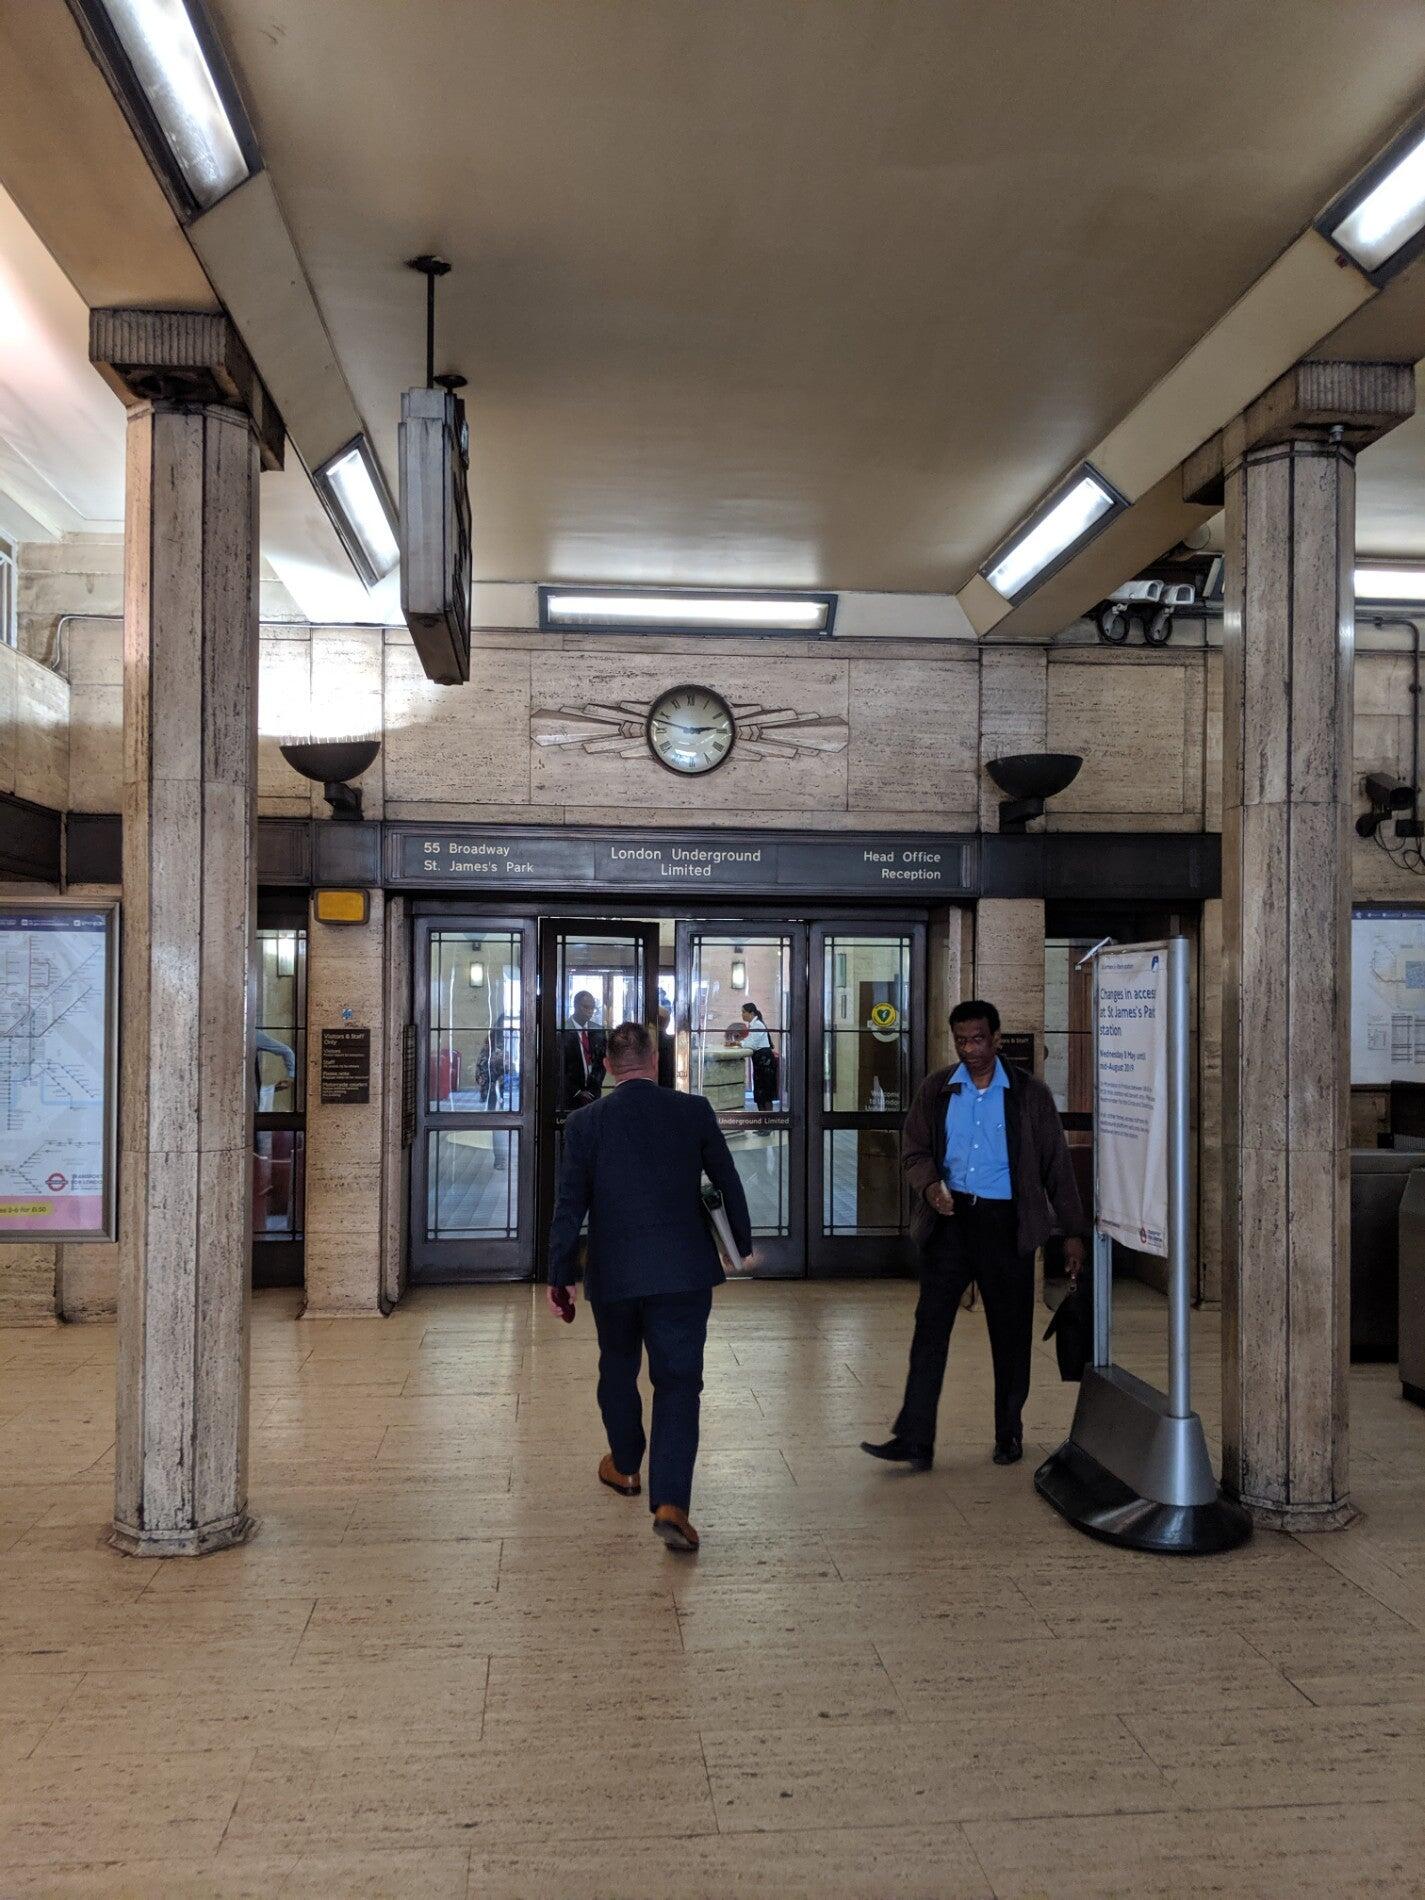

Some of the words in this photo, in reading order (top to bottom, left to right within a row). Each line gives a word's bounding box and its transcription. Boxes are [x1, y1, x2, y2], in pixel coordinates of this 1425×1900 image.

[424, 842, 440, 853] 55
[449, 842, 510, 856] Broadway
[611, 847, 661, 860] London
[672, 848, 760, 863] Underground
[864, 851, 894, 862] Head
[903, 851, 941, 862] Office
[424, 860, 440, 871] St.
[449, 861, 498, 872] James's
[506, 862, 534, 873] Park
[661, 864, 712, 876] Limited
[882, 868, 941, 880] Reception
[1100, 988, 1123, 1002] Changes
[1125, 989, 1133, 1000] in
[1100, 1008, 1106, 1018] at
[1115, 1006, 1142, 1018] James's
[1100, 1024, 1121, 1036] station
